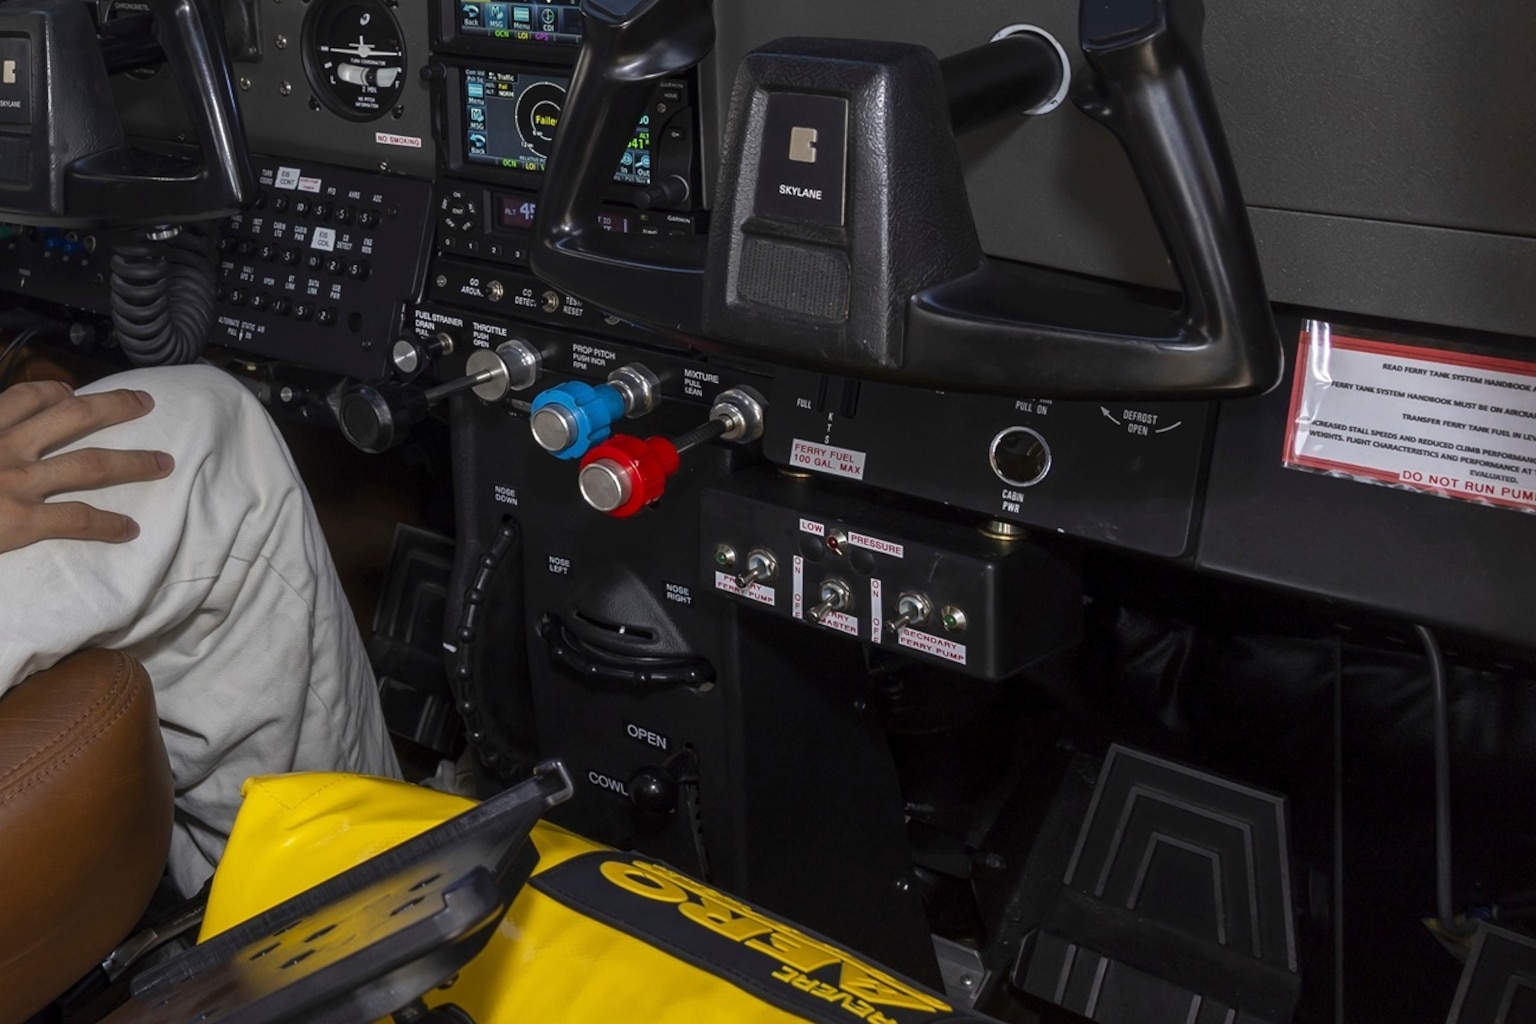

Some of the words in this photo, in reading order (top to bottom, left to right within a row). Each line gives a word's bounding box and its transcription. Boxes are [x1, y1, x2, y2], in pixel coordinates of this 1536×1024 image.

[0, 100, 21, 108] SKYLANE
[377, 135, 388, 143] NO
[389, 136, 419, 146] SMOKING
[779, 184, 822, 200] SKYLANE
[415, 310, 431, 321] FUEL
[432, 313, 463, 327] STRAINER
[415, 320, 435, 330] DRAIN
[472, 322, 507, 336] THROTTLE
[473, 331, 489, 340] PUSH
[473, 338, 489, 348] OPEN
[573, 343, 593, 355] PROP
[593, 347, 616, 360] PITCH
[573, 353, 590, 363] PUSH
[573, 360, 587, 370] RPM
[684, 369, 719, 384] MIXTURE
[684, 378, 701, 388] PULL
[1382, 363, 1403, 372] READ
[1405, 366, 1427, 375] FERRY
[1429, 370, 1450, 379] TANK
[1452, 373, 1482, 384] SYSTEM
[1484, 379, 1531, 392] HANDBOOK
[685, 386, 703, 397] LEAN
[1331, 380, 1353, 389] FERRY
[1355, 384, 1375, 393] TANK
[1376, 388, 1405, 398] SYSTEM
[1407, 393, 1452, 406] HANDBOOK
[1453, 400, 1477, 410] MUST
[1478, 404, 1488, 412] BE
[1490, 406, 1503, 414] ON
[797, 398, 812, 409] FULL
[1015, 400, 1032, 413] PULL
[1036, 405, 1047, 415] ON
[1123, 409, 1158, 425] DEFROST
[1127, 423, 1148, 436] OPEN
[1402, 413, 1440, 425] TRANSFER
[1443, 420, 1466, 429] FERRY
[1468, 424, 1490, 434] TANK
[1491, 428, 1511, 438] FUEL
[1349, 426, 1369, 435] STALL
[1371, 430, 1398, 440] SPEEDS
[1399, 435, 1416, 444] AND
[1418, 437, 1454, 450] REDUCED
[1455, 444, 1481, 454] CLIMB
[794, 443, 827, 456] FERRY
[830, 451, 855, 463] FUEL
[1346, 436, 1372, 446] FLIGHT
[1372, 440, 1439, 459] CHARACTERISTICS
[1440, 453, 1458, 462] AND
[1460, 456, 1520, 473] PERFORMANCE
[793, 453, 810, 465] 100
[814, 458, 837, 470] GAL.
[840, 463, 861, 475] MAX
[1402, 470, 1423, 482] DO
[1428, 475, 1459, 488] NOT
[1464, 481, 1495, 494] RUN
[495, 485, 516, 498] NOSE
[1002, 489, 1024, 502] CABIN
[495, 493, 518, 506] DOWN
[1002, 501, 1020, 514] PWR
[801, 521, 823, 534] LOW
[850, 534, 902, 556] PRESSURE
[549, 555, 570, 568] NOSE
[549, 563, 569, 575] LEFT
[666, 583, 690, 596] NOSE
[717, 581, 746, 594] FERRY
[748, 591, 773, 603] PUMP
[666, 591, 692, 605] RIGHT
[819, 617, 857, 633] MASTER
[903, 629, 957, 650] SECNDARY
[900, 637, 932, 652] FERRY
[936, 647, 964, 662] PUMP
[627, 723, 666, 750] OPEN
[588, 771, 629, 797] COWL
